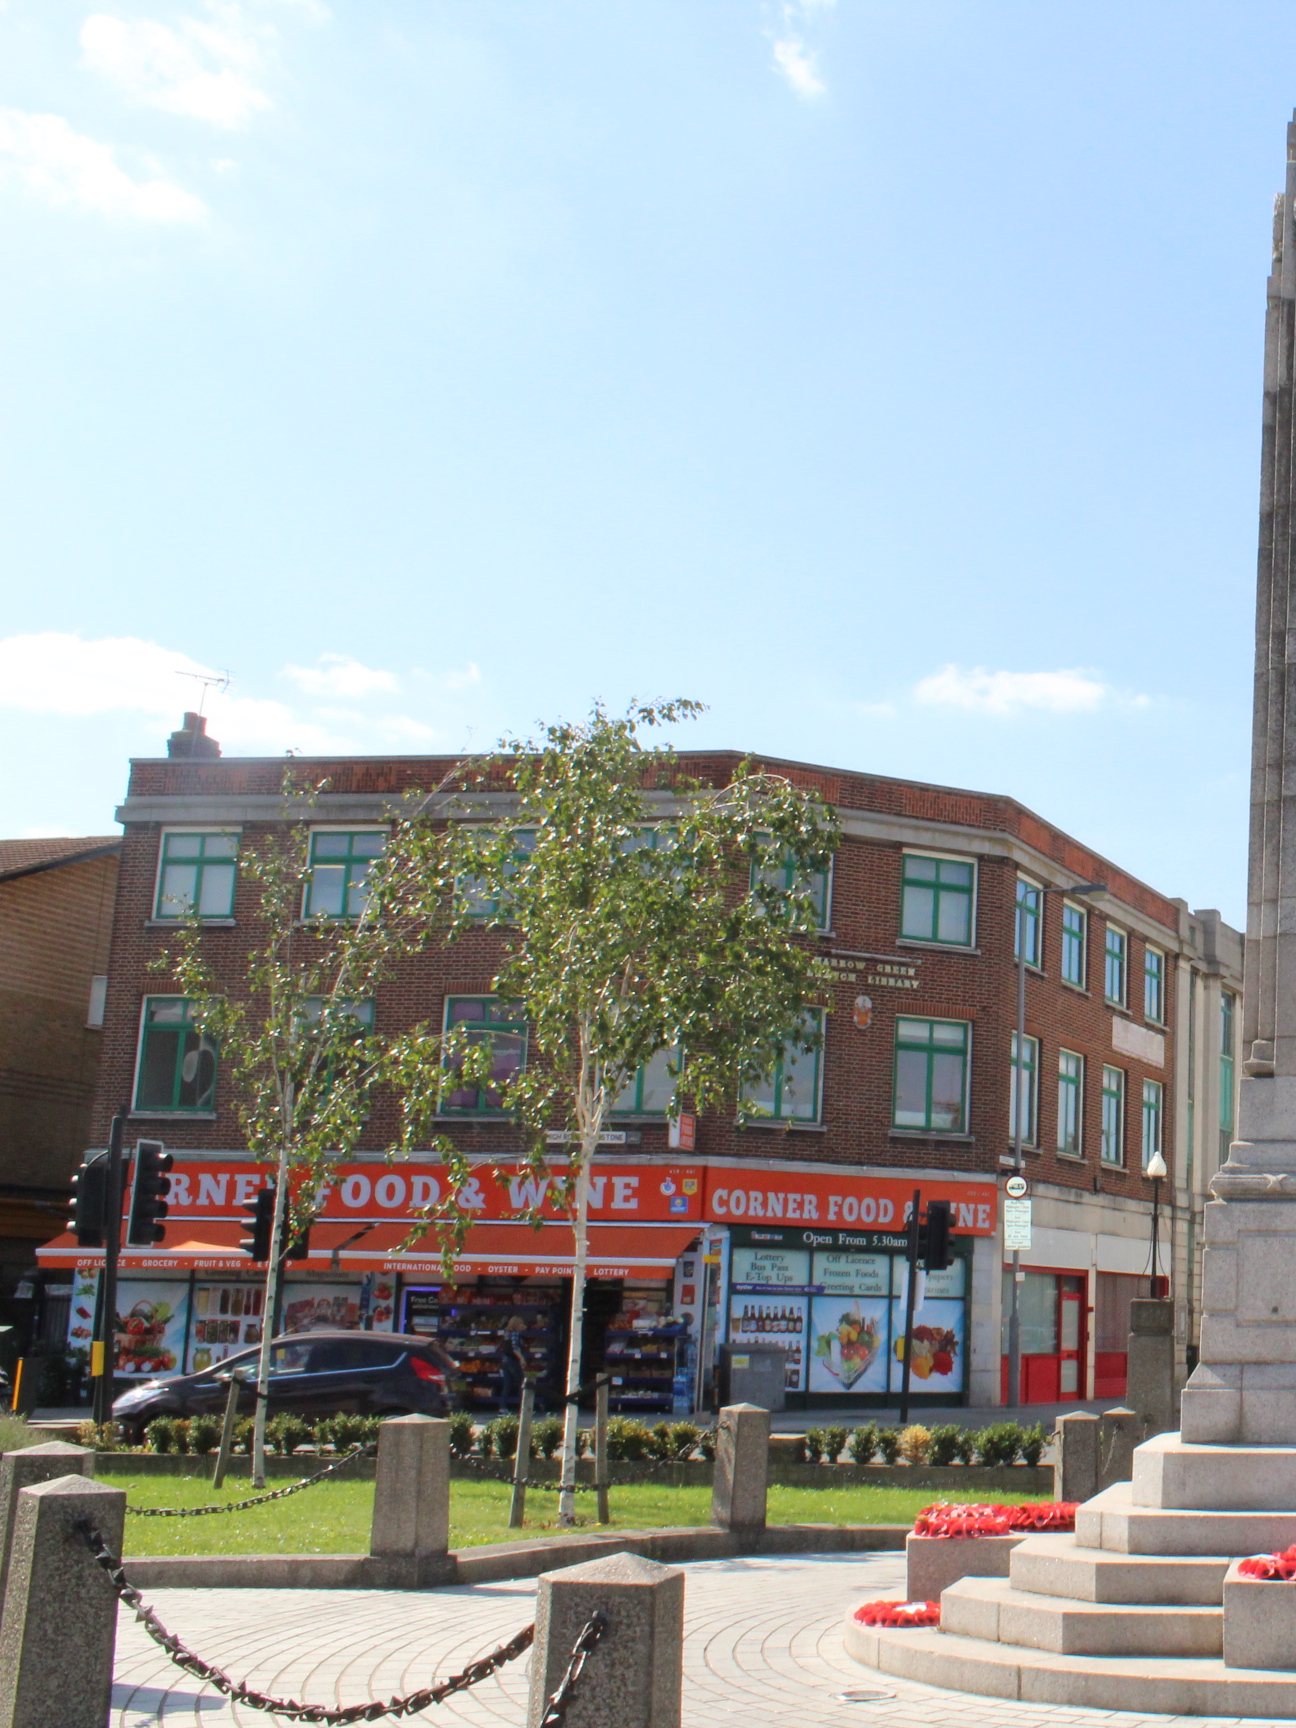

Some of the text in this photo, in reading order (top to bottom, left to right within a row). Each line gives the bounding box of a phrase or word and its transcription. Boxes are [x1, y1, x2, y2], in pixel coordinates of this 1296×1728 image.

[877, 963, 915, 976] GREEN
[867, 975, 920, 989] LIBRARY
[457, 1176, 487, 1208] &
[711, 1188, 819, 1220] CORNER
[827, 1194, 894, 1223] FOOD
[802, 1231, 908, 1247] Open From 5.30am
[76, 1259, 92, 1267] OFF
[141, 1259, 179, 1267] GROCERY
[194, 1259, 217, 1267] FRUIT
[754, 1251, 786, 1263] Lottery
[826, 1254, 877, 1264] Off Licence
[453, 1264, 472, 1272] OOD
[487, 1265, 519, 1274] OYSTER
[535, 1266, 552, 1275] PAY
[593, 1268, 630, 1276] LOTTERY
[750, 1262, 789, 1272] Bus Pass
[823, 1267, 879, 1278] Frozen Foods
[745, 1271, 793, 1284] E-Top Ups
[820, 1282, 855, 1293] Greeting
[859, 1282, 882, 1292] Cards
